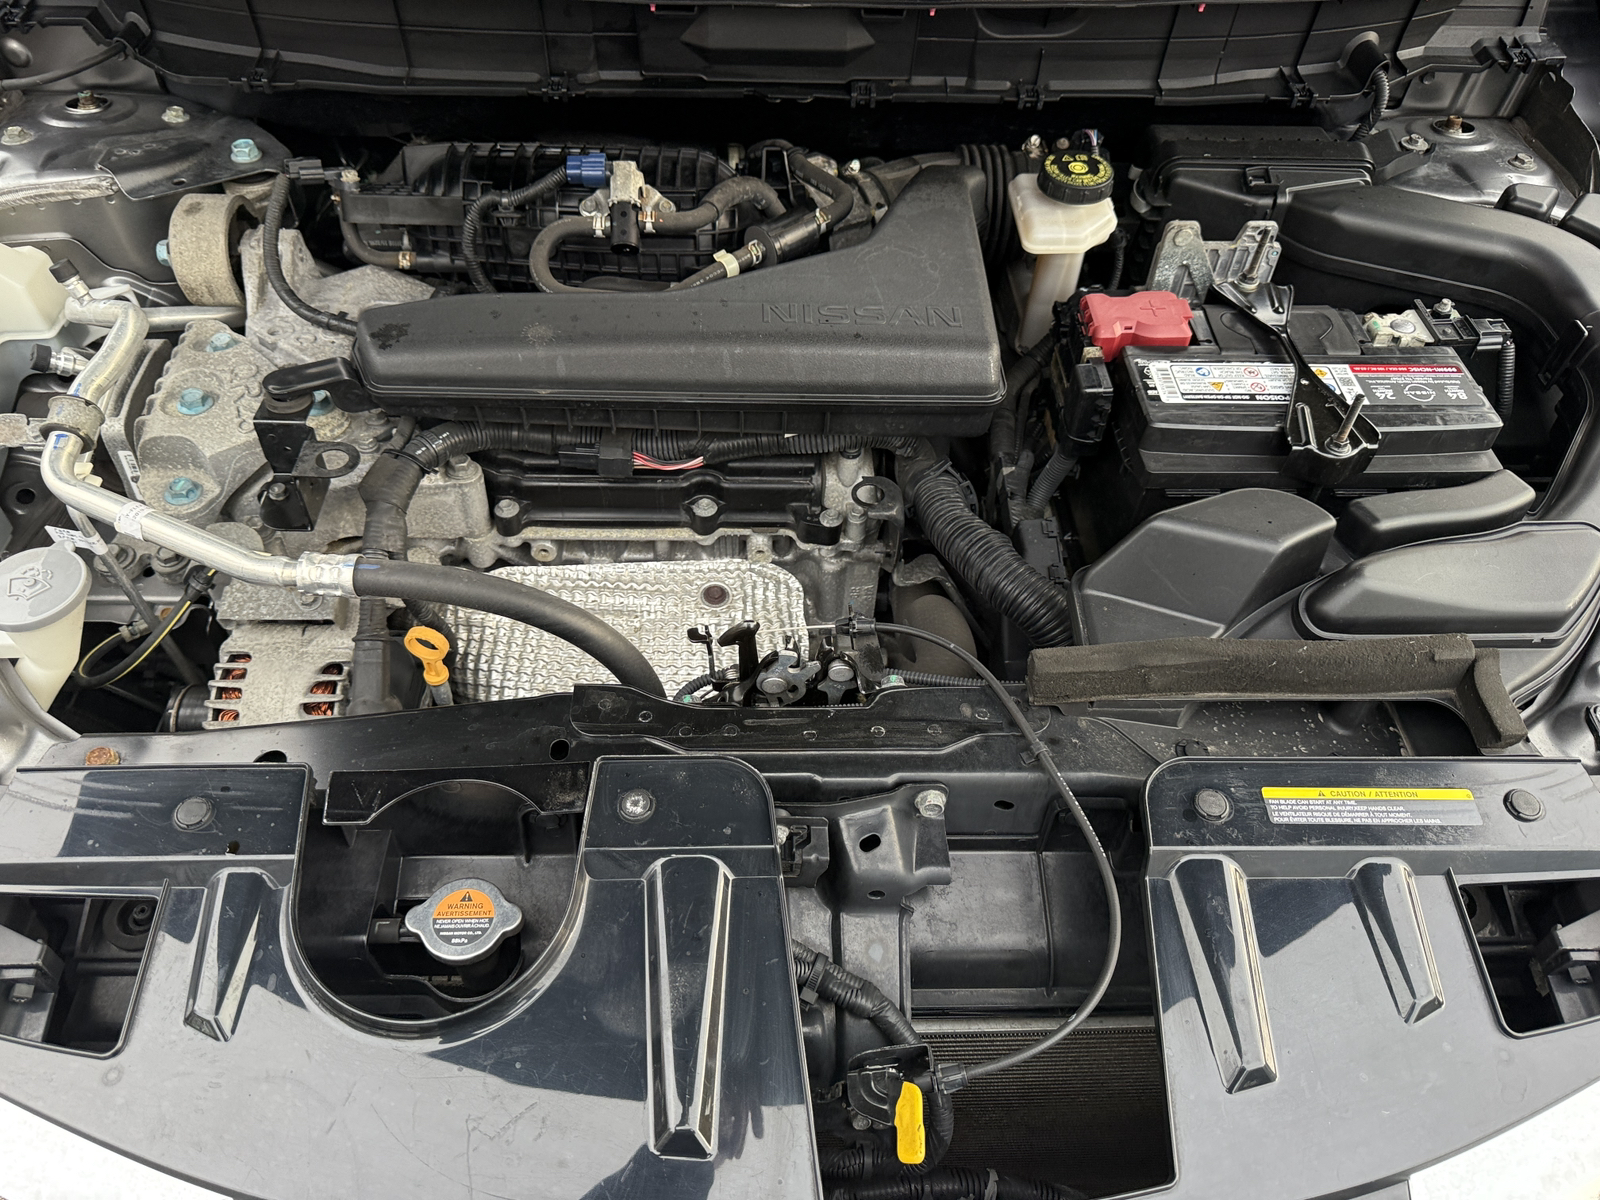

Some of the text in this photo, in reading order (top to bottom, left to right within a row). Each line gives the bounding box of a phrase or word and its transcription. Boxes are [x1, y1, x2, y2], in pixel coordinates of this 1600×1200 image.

[761, 303, 963, 328] NISSAN
[1375, 392, 1396, 400] 24
[1447, 392, 1468, 400] 84
